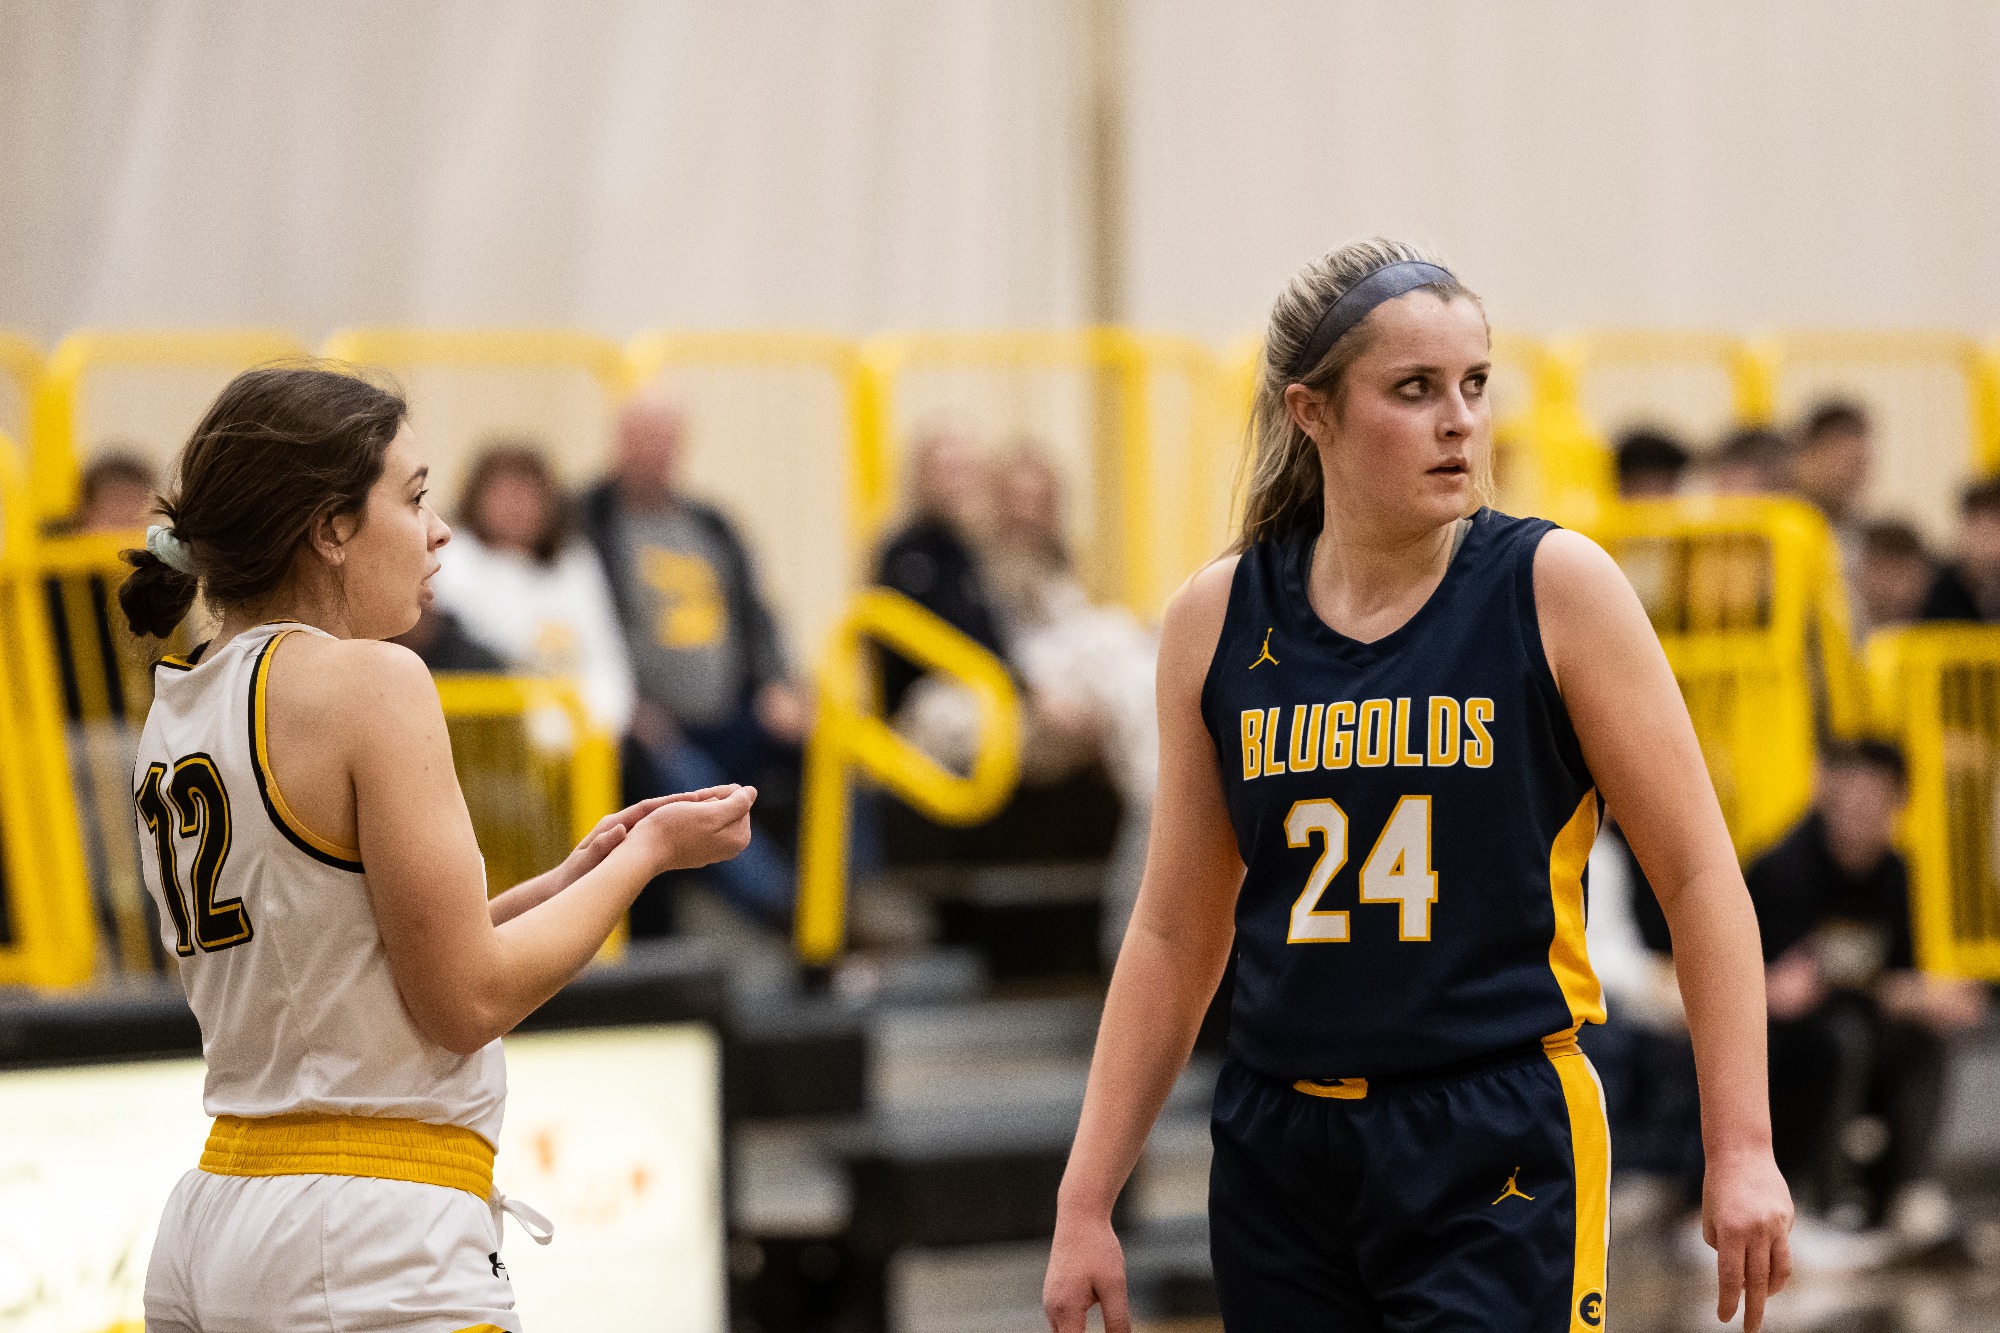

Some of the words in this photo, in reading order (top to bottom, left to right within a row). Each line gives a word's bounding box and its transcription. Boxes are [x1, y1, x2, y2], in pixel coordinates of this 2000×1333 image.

[1240, 696, 1494, 781] BLUGOLDS
[135, 752, 254, 957] 12
[1283, 794, 1438, 944] 24
